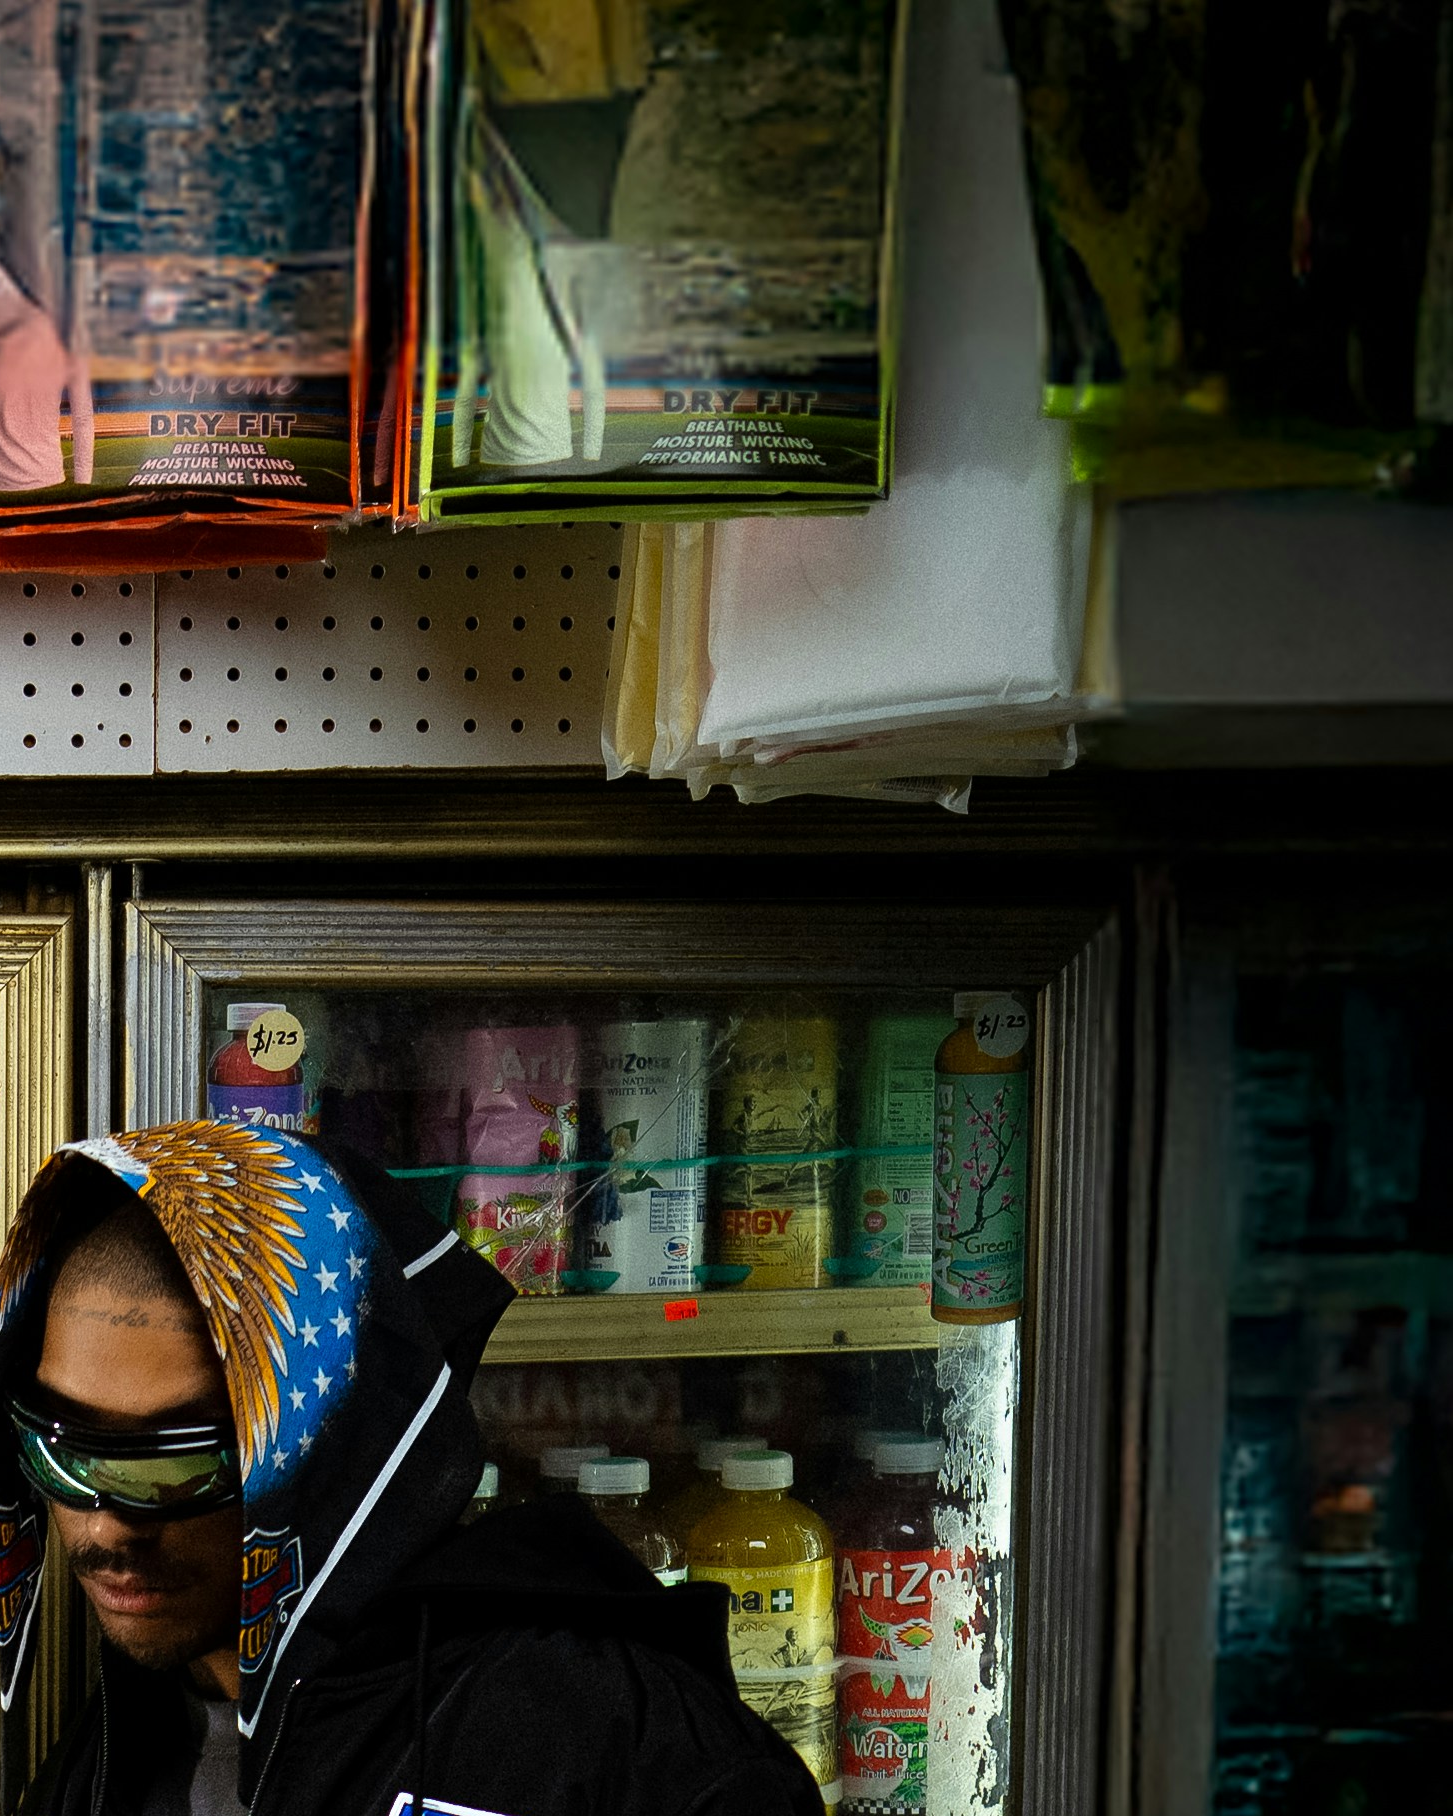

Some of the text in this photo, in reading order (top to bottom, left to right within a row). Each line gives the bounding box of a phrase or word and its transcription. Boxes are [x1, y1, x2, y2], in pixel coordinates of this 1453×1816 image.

[662, 388, 819, 416] DRY FIT
[148, 412, 298, 438] DRY FIT
[685, 420, 785, 434] BREATHABLE
[172, 442, 268, 456] BREATHABLE
[651, 435, 815, 450] MOISTURE WICKING
[141, 456, 296, 472] MOISTURE WICKING
[637, 451, 828, 467] PERFORMANCE FABRIC
[127, 471, 308, 488] PERFORMANCE FABRIC
[977, 1016, 1027, 1040] $1.25
[249, 1023, 299, 1058] $1.25
[964, 1235, 1014, 1255] Green
[756, 1569, 782, 1580] MADE
[838, 1557, 985, 1606] AriZona
[859, 1765, 925, 1781] Fruit Juice
